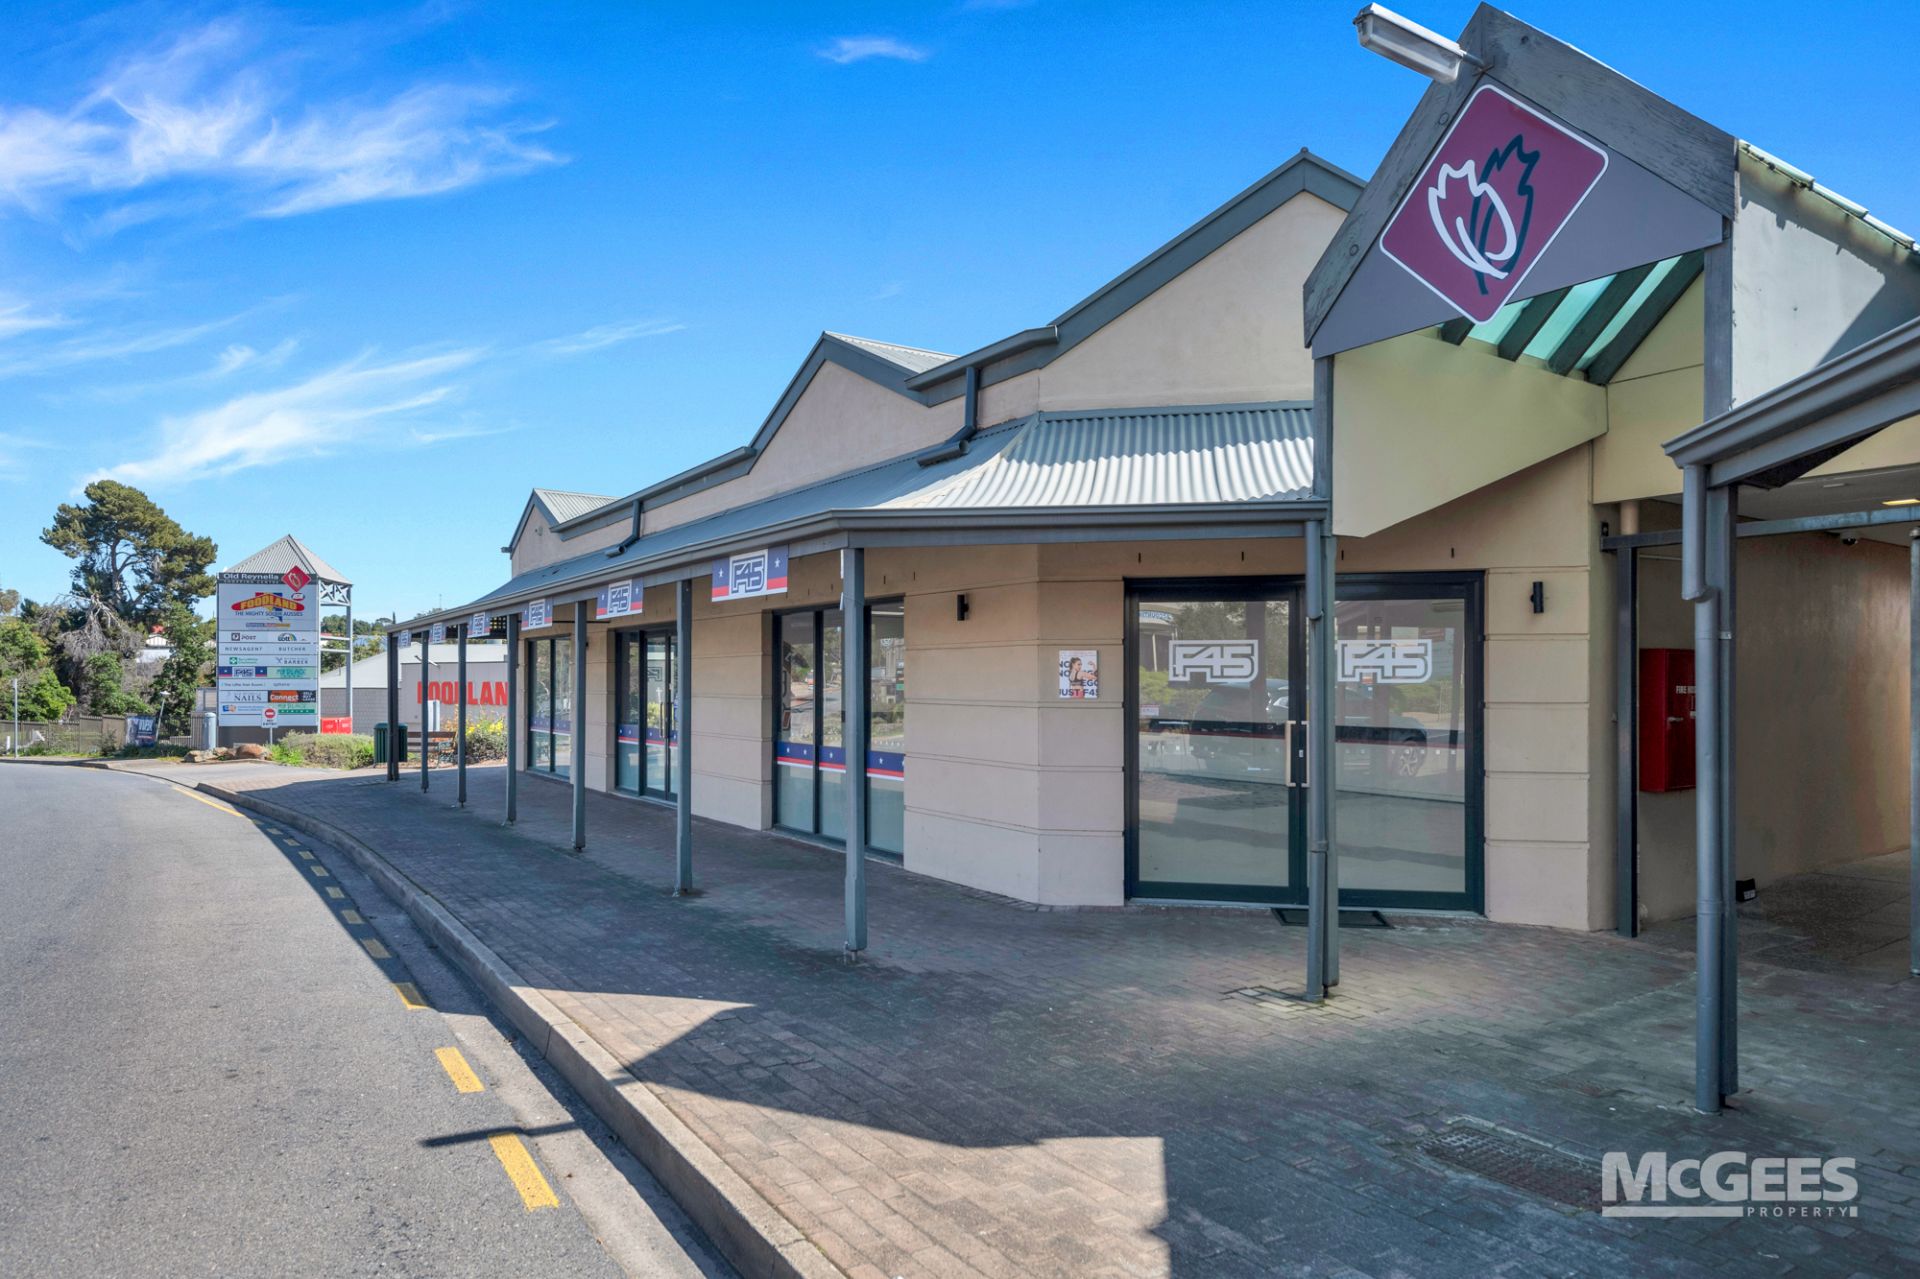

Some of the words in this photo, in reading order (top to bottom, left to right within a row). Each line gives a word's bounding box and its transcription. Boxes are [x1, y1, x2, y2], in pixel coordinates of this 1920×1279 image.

[241, 573, 279, 581] Reynella
[732, 557, 764, 592] F45
[239, 593, 297, 610] FOODLAND
[609, 585, 630, 612] F45
[1171, 642, 1256, 680] F45
[1340, 641, 1429, 681] F45
[270, 694, 299, 702] Connect
[1676, 685, 1687, 694] FIRE
